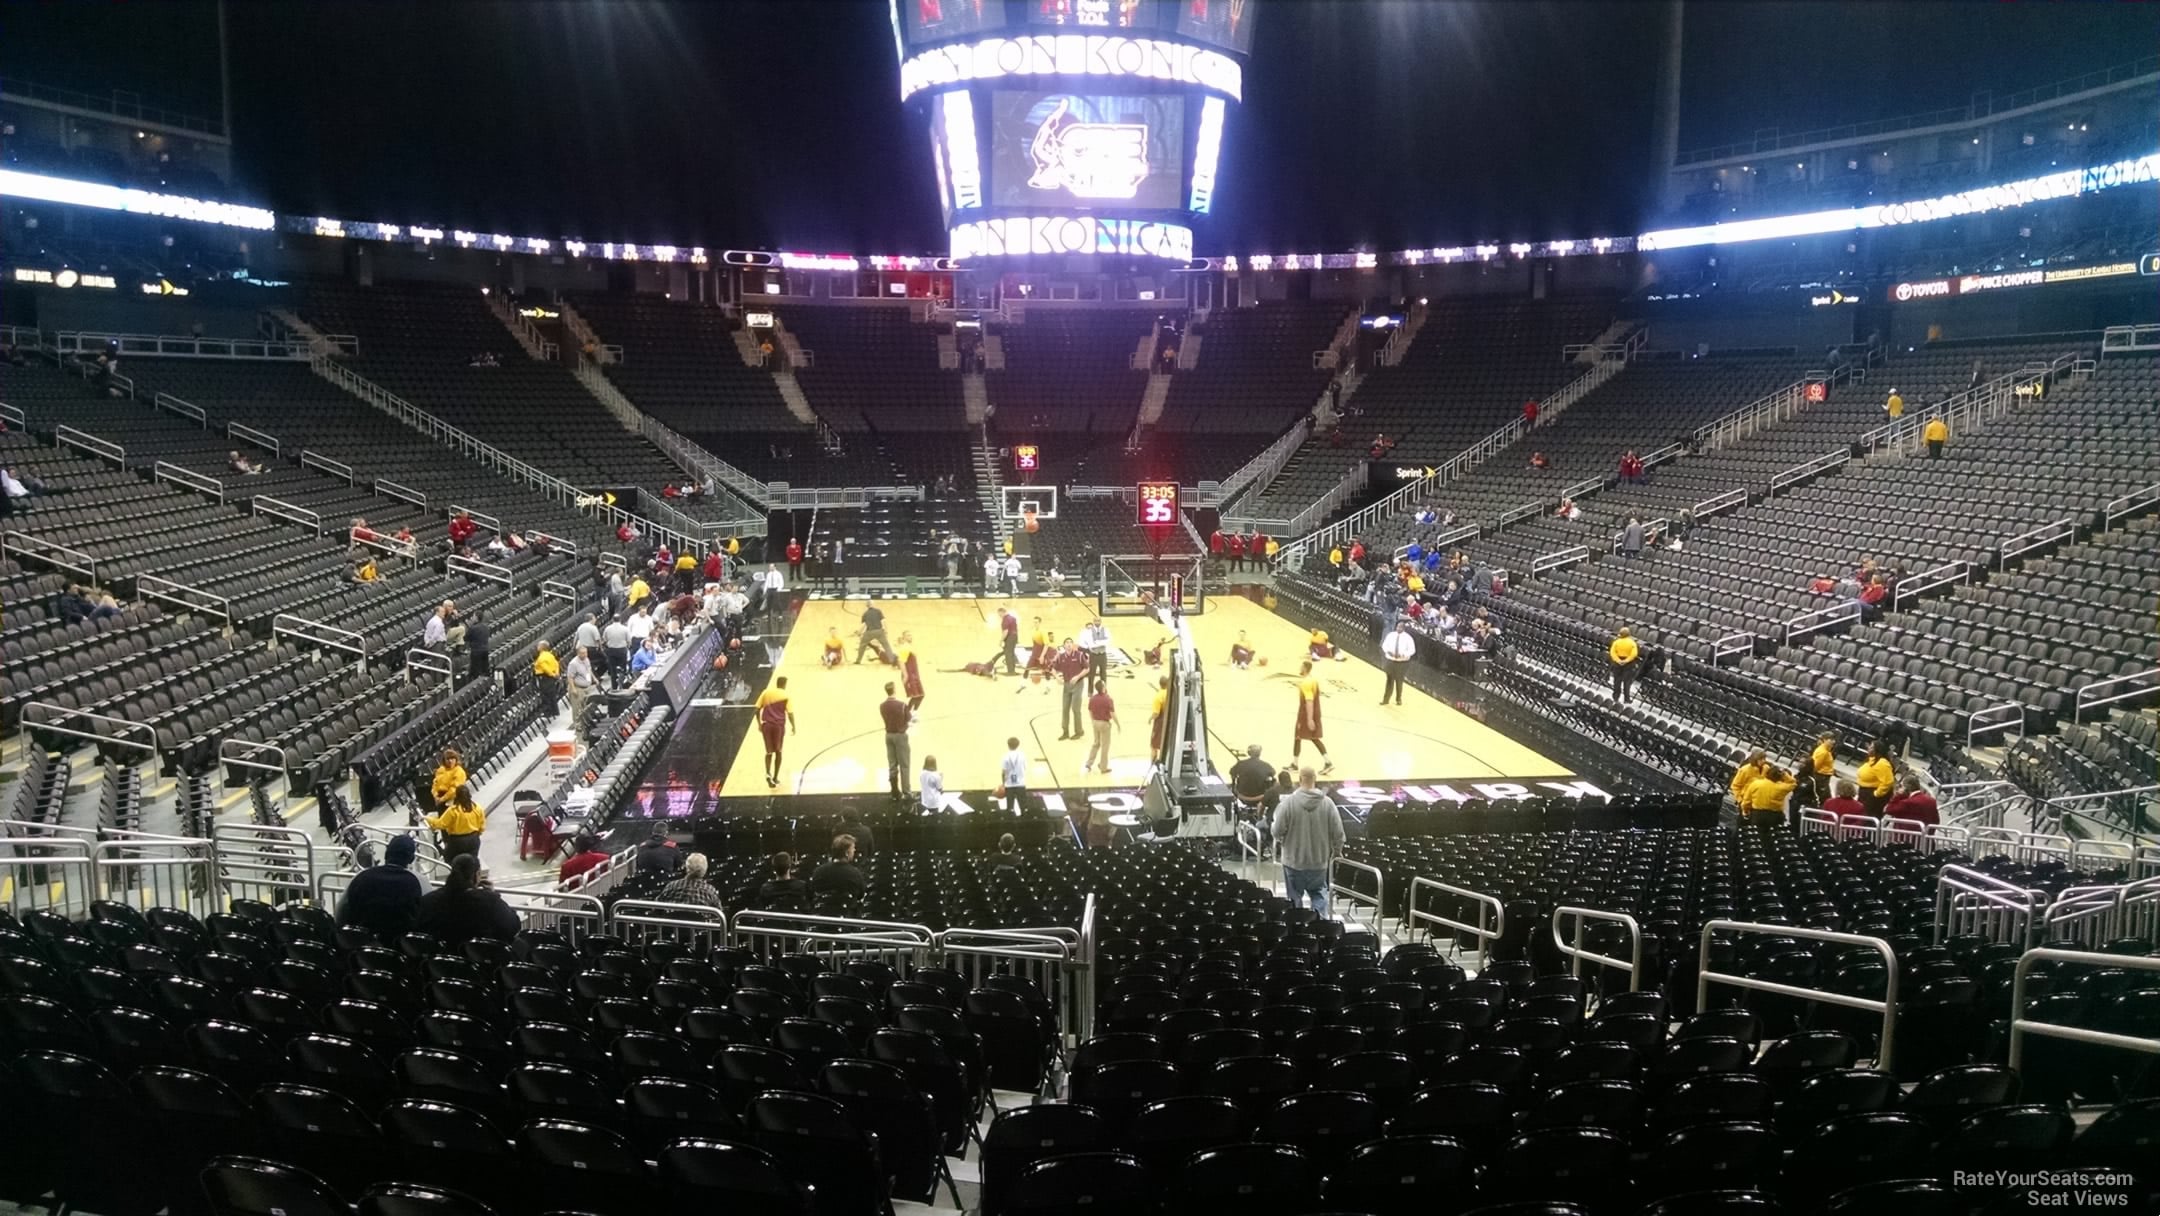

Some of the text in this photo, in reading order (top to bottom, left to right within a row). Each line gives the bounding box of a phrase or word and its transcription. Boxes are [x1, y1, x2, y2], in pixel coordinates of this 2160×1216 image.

[1911, 280, 1949, 298] TOYOTA
[1979, 275, 2002, 289] PRICE
[2003, 270, 2043, 287] CHOPPER
[1020, 455, 1035, 468] 35
[1396, 467, 1423, 479] Sprint
[1142, 486, 1176, 499] 33:05
[576, 495, 604, 508] Sprint
[1146, 498, 1171, 522] 35
